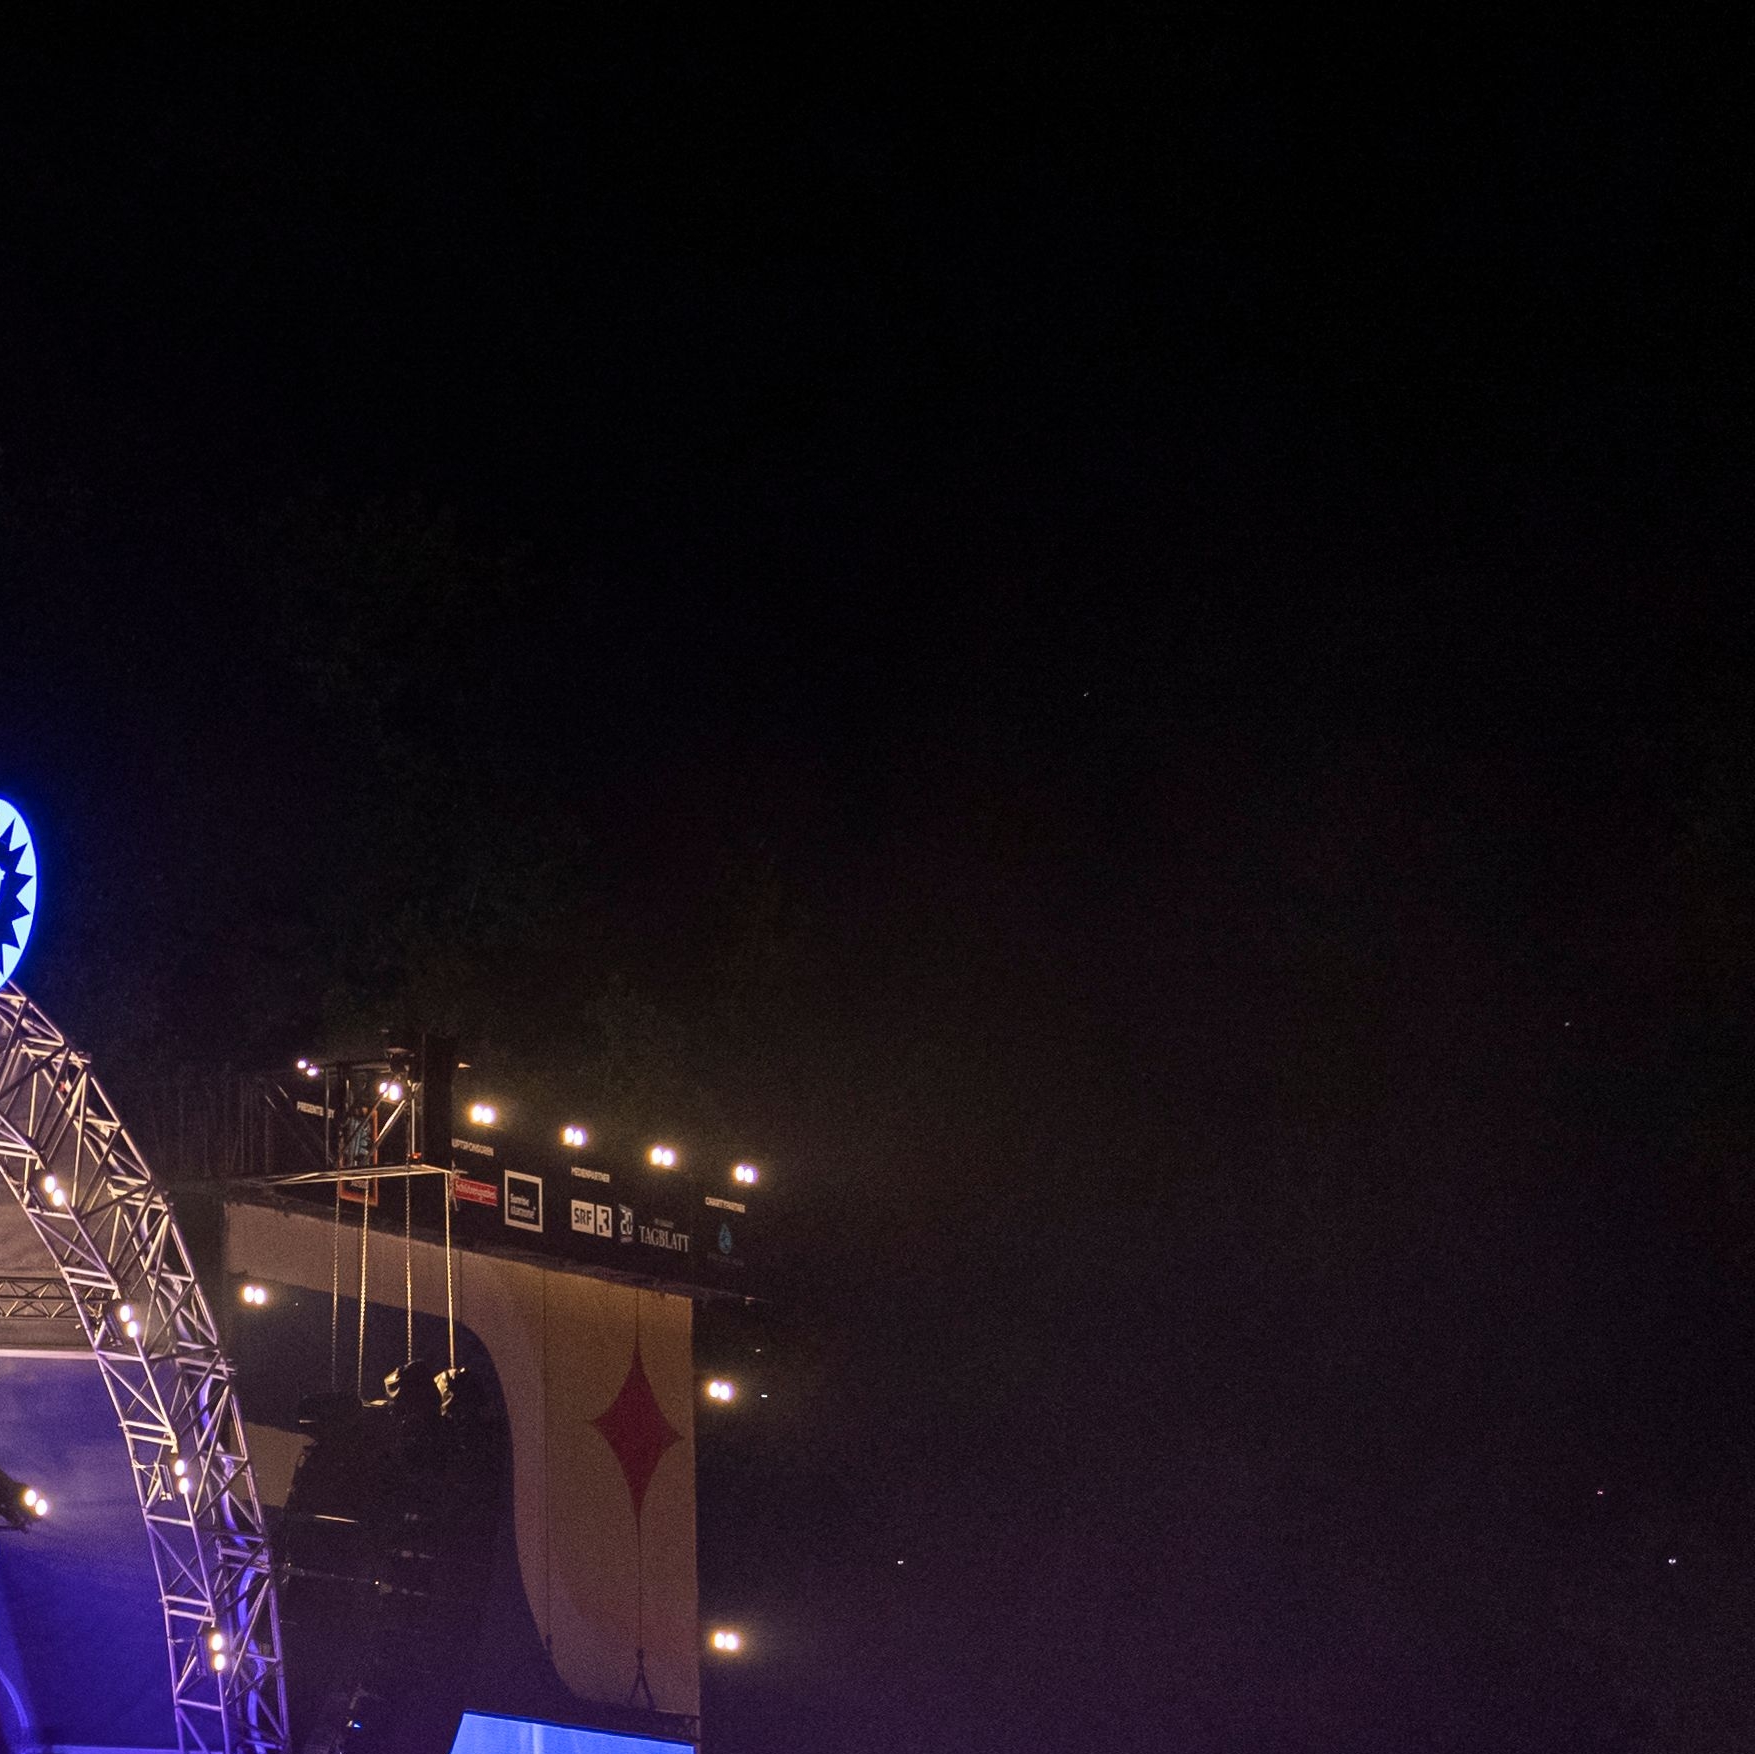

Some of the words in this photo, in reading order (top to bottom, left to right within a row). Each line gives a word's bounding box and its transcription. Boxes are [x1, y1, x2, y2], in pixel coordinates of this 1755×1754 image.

[573, 1207, 593, 1226] SRF
[599, 1208, 610, 1233] 3
[638, 1225, 691, 1253] TAGBLATT
